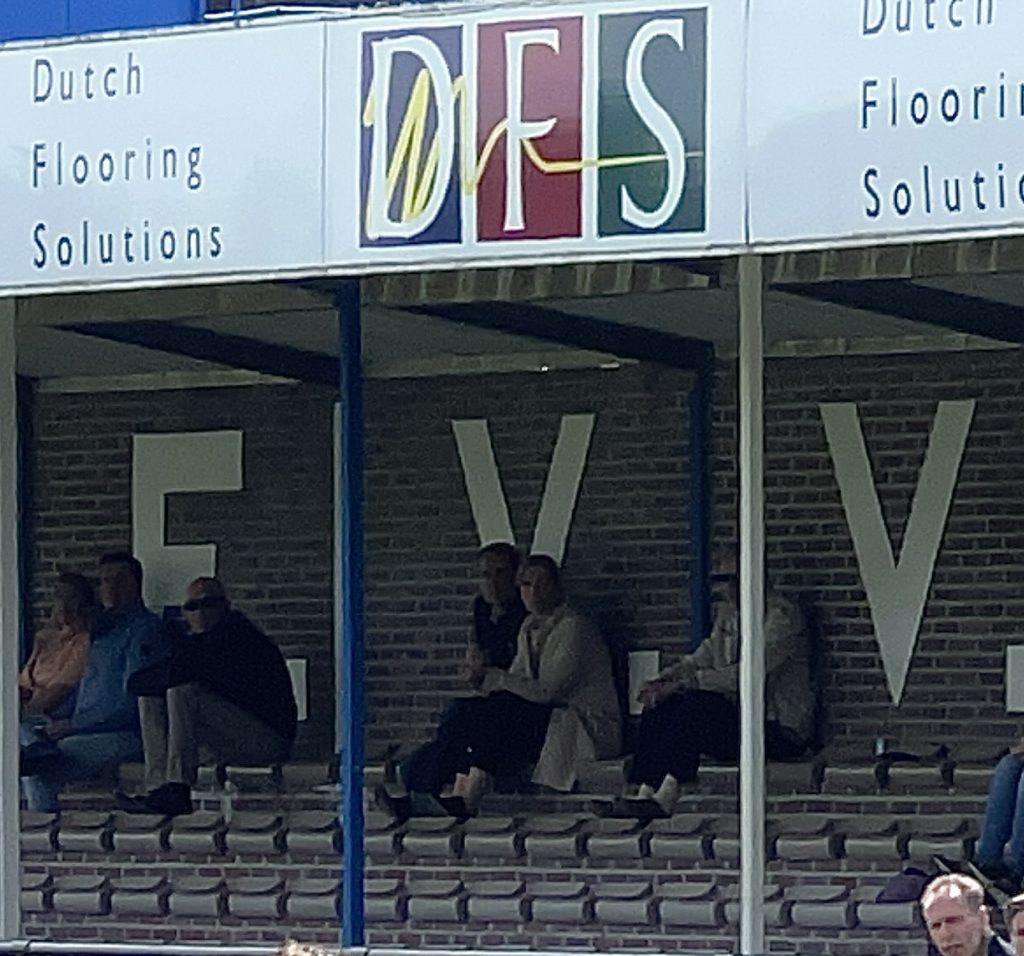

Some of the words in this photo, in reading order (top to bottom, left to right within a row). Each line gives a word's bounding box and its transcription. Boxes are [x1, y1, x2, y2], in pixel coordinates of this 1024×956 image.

[863, 0, 993, 35] Dutch
[33, 53, 142, 103] Dutch
[366, 18, 685, 239] DFS
[32, 140, 203, 189] Flooring
[32, 222, 224, 269] Solutions
